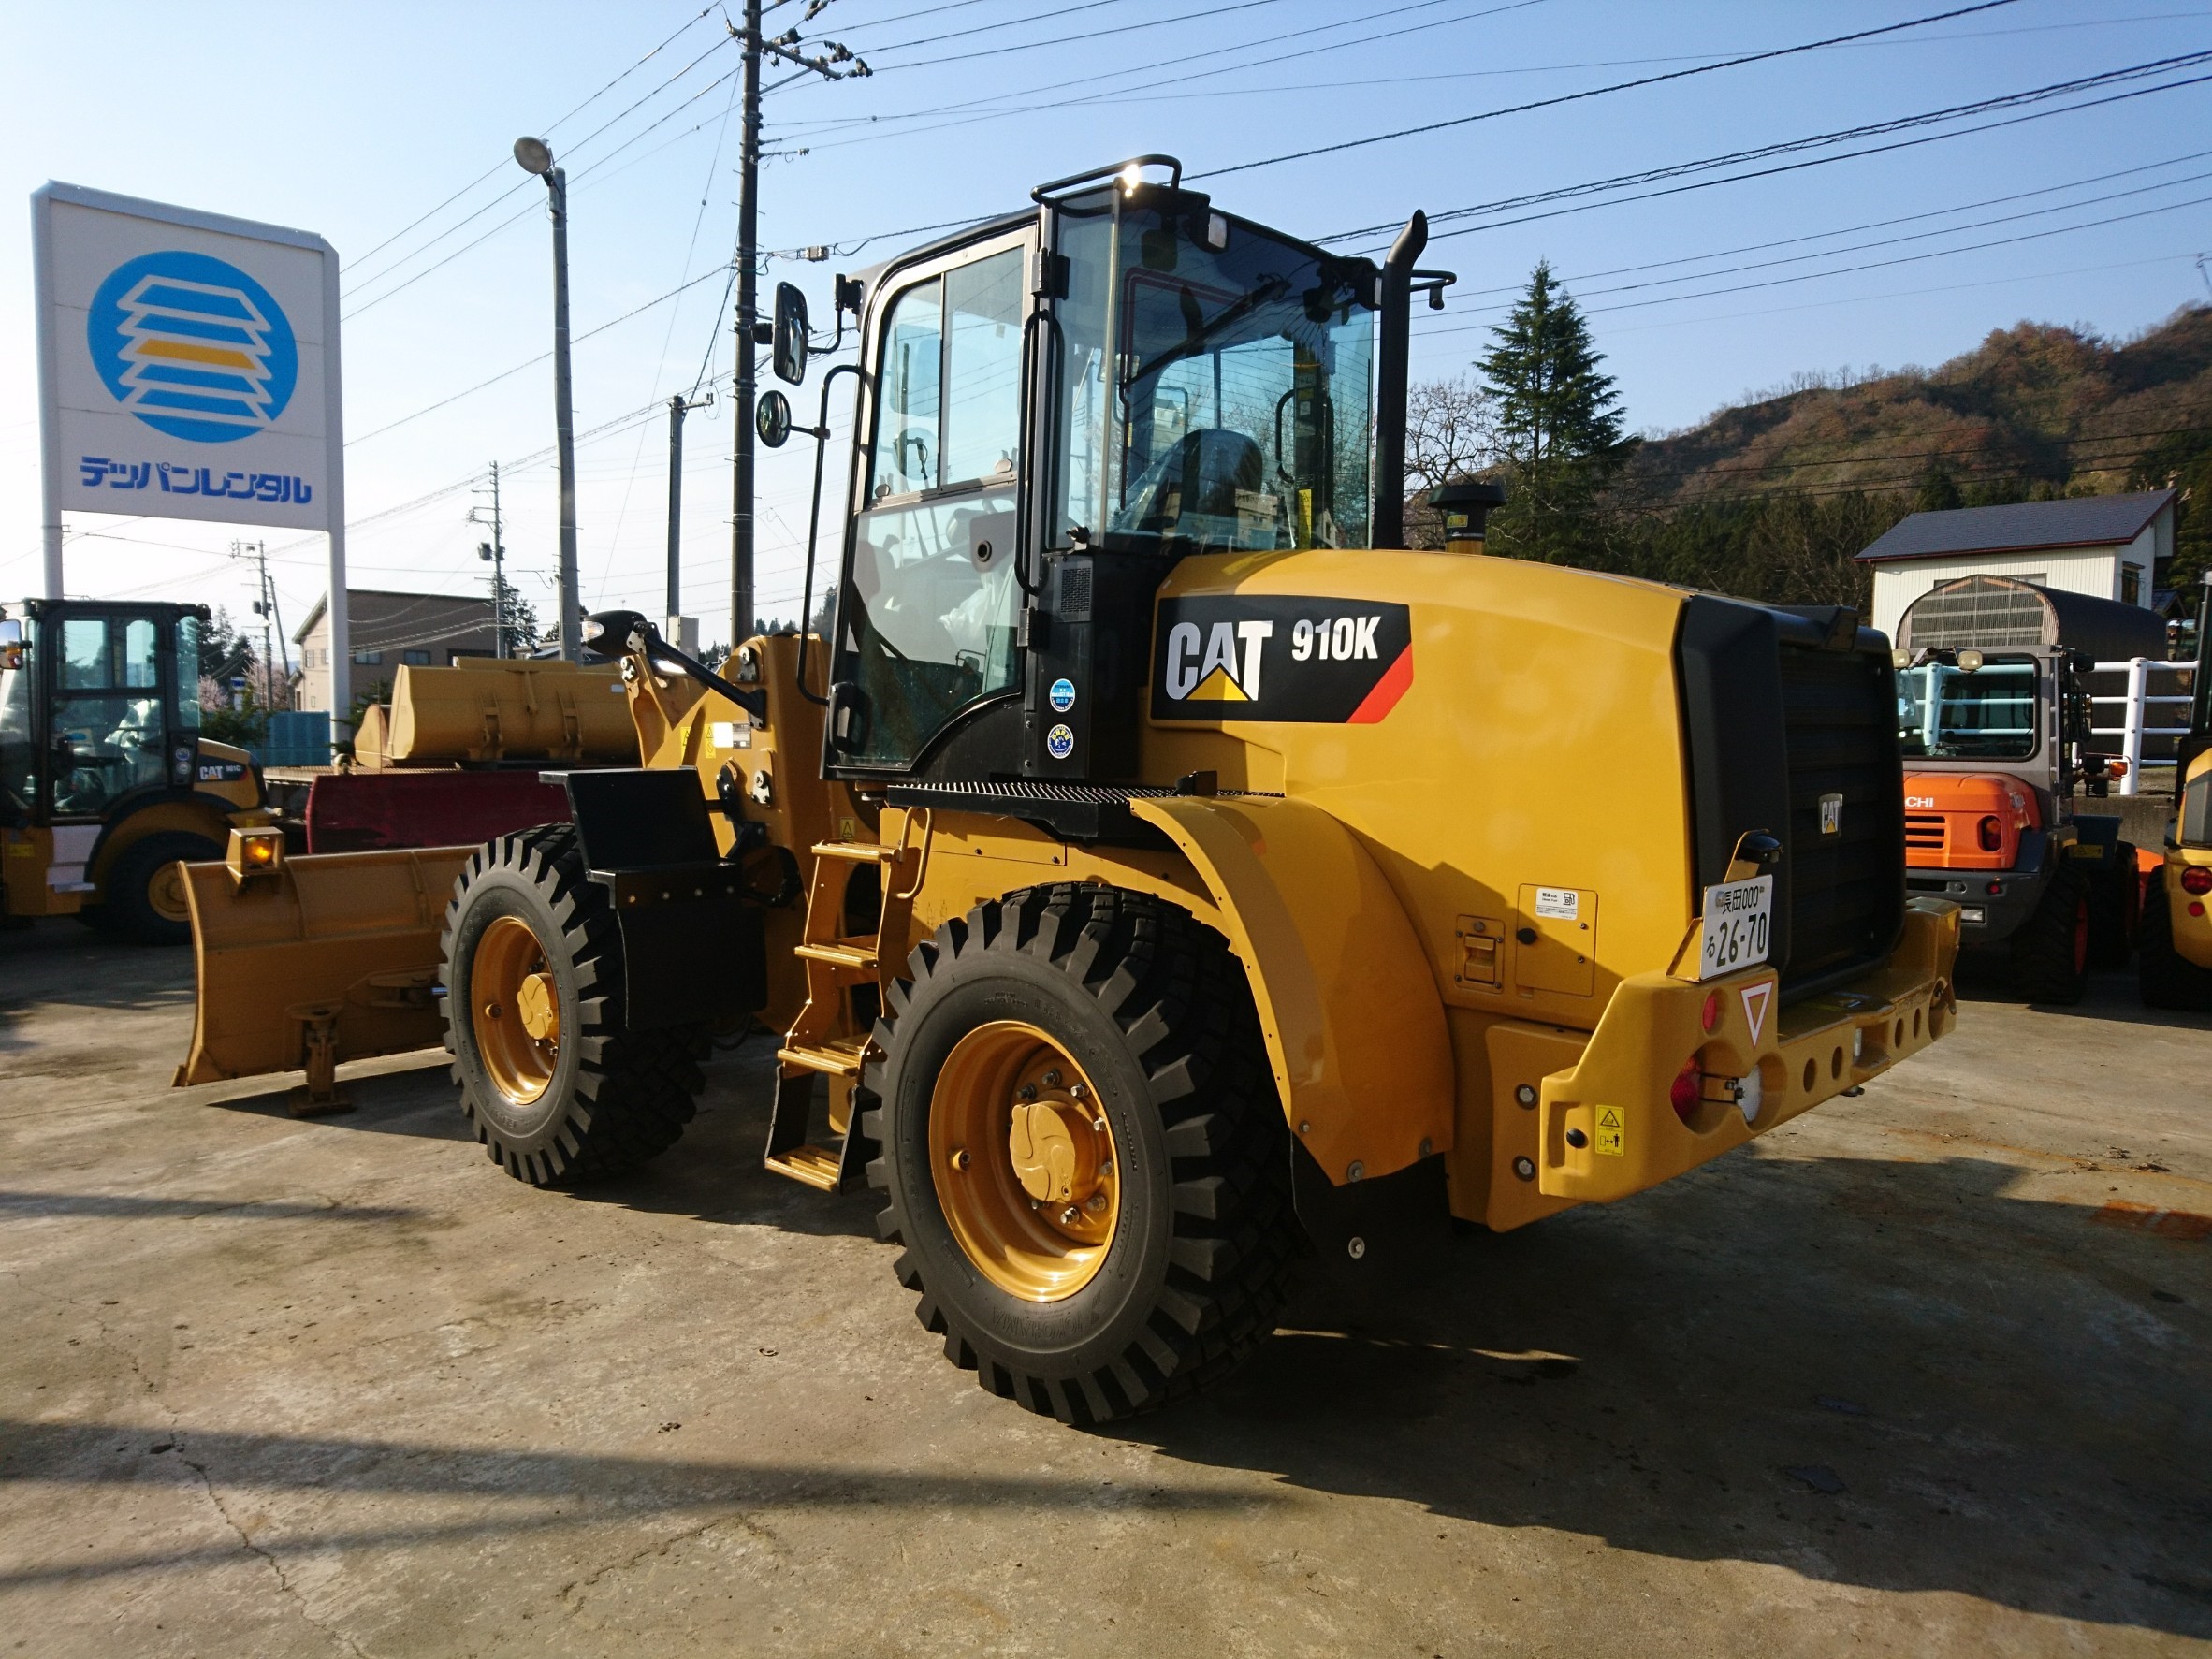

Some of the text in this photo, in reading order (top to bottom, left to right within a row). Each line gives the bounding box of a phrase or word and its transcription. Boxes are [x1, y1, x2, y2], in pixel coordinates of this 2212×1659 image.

[80, 456, 312, 504] テッパンレンタル
[1165, 616, 1382, 701] CAT 910K
[199, 766, 223, 780] CAT
[1821, 801, 1840, 834] CAT
[1716, 911, 1768, 968] 26-70
